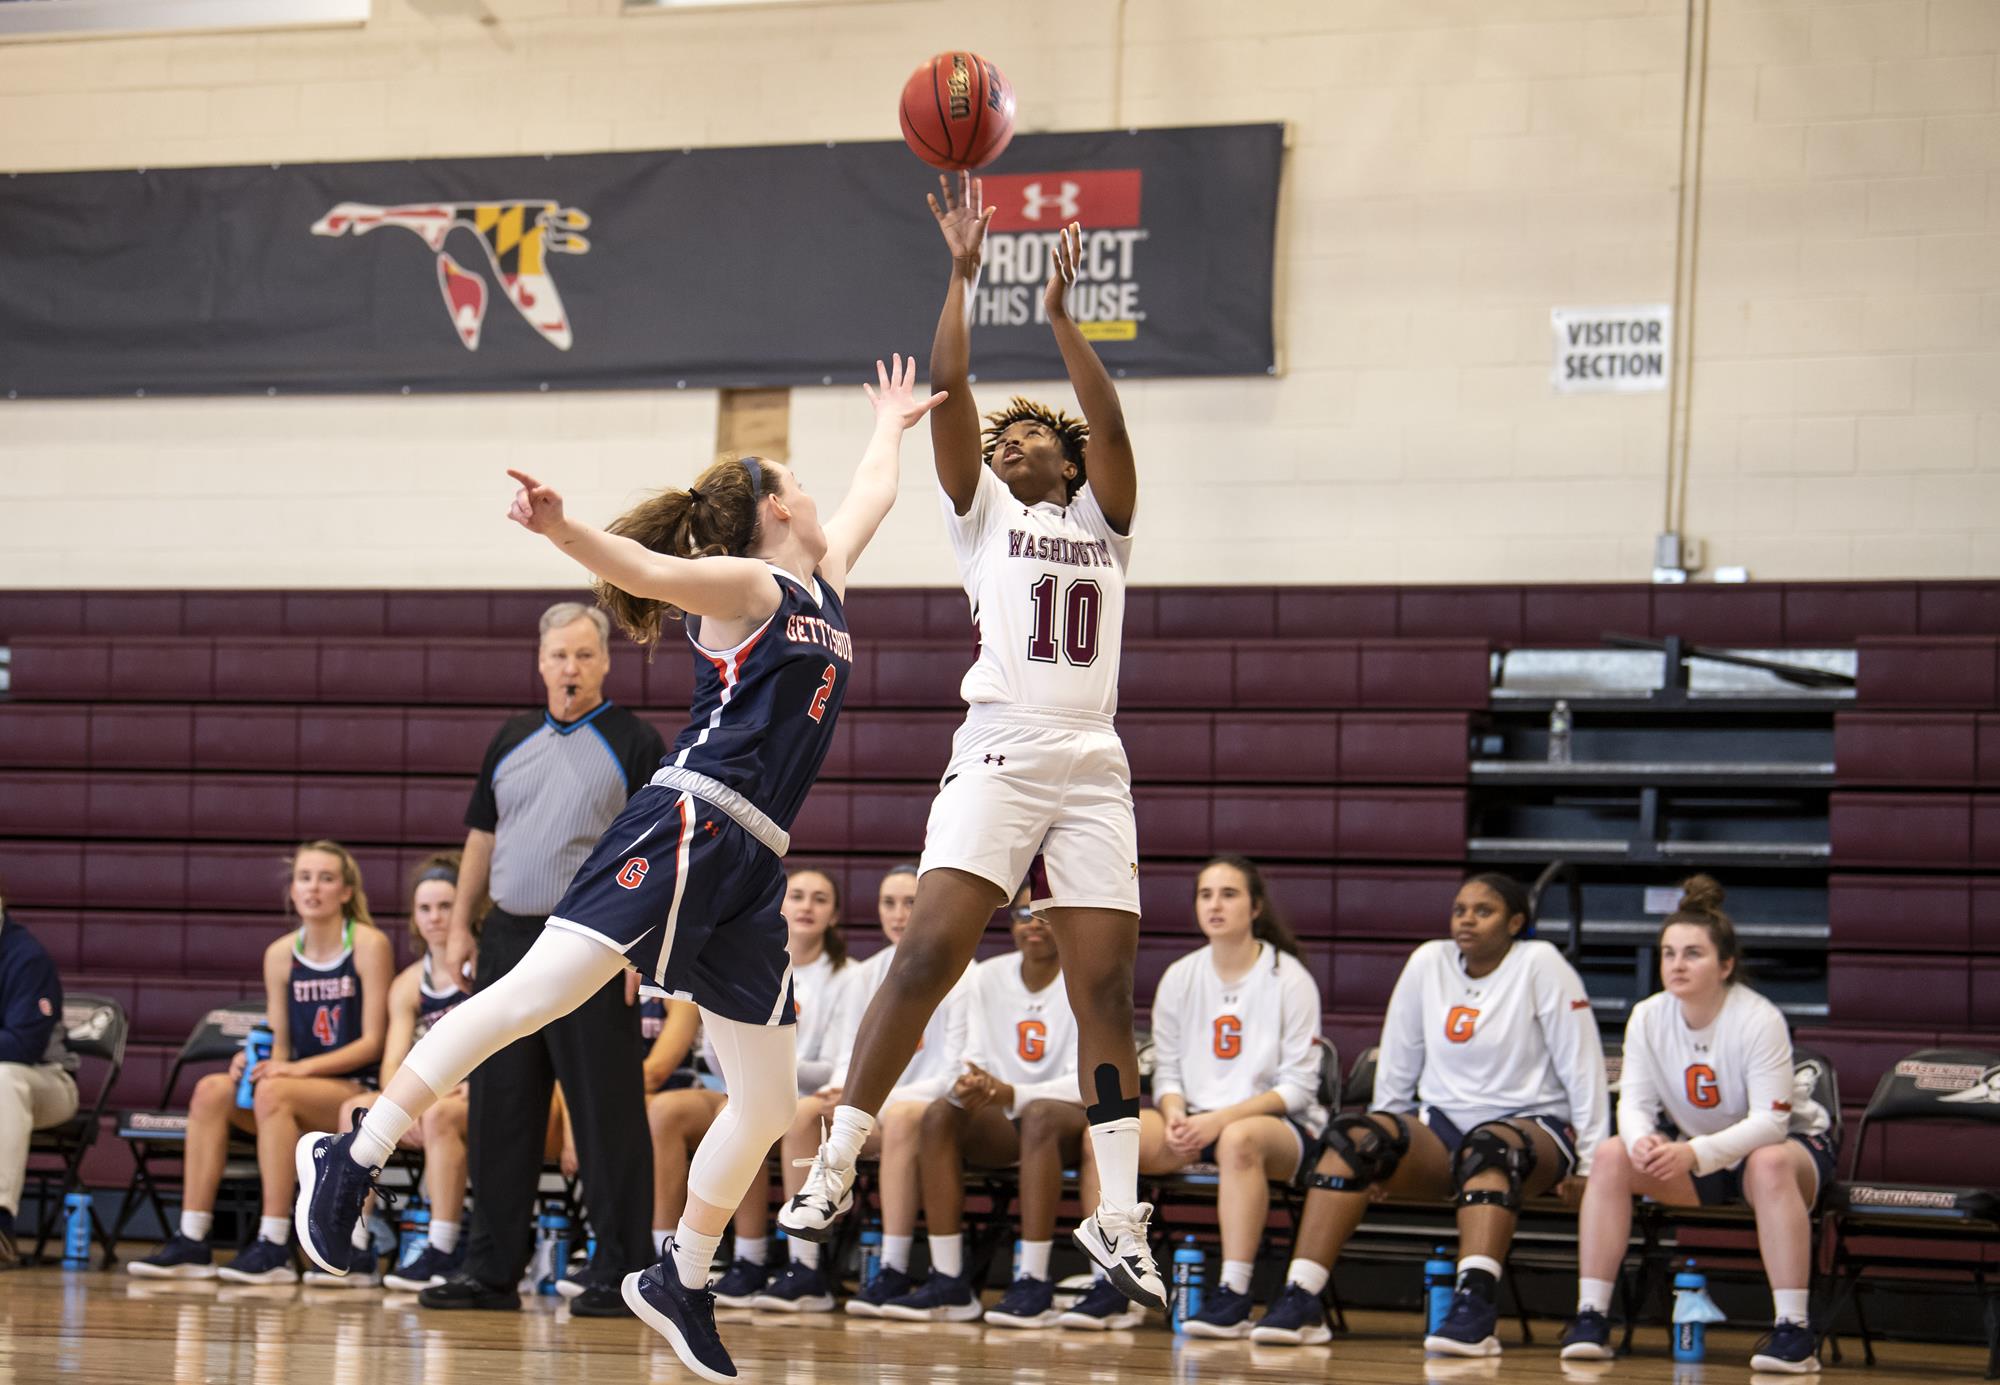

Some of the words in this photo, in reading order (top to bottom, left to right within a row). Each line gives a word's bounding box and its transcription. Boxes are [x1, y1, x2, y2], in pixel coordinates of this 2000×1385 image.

[981, 230, 1138, 284] ROTCT
[1567, 320, 1661, 345] VISITOR
[1565, 353, 1662, 379] SECTION
[1008, 529, 1113, 568] WASHINGTN
[1027, 573, 1102, 667] 10
[808, 664, 836, 724] 2
[616, 857, 649, 889] G
[1016, 1020, 1046, 1062] G
[1213, 1015, 1242, 1060] G
[1445, 1006, 1480, 1044] G
[1685, 1063, 1721, 1109] G
